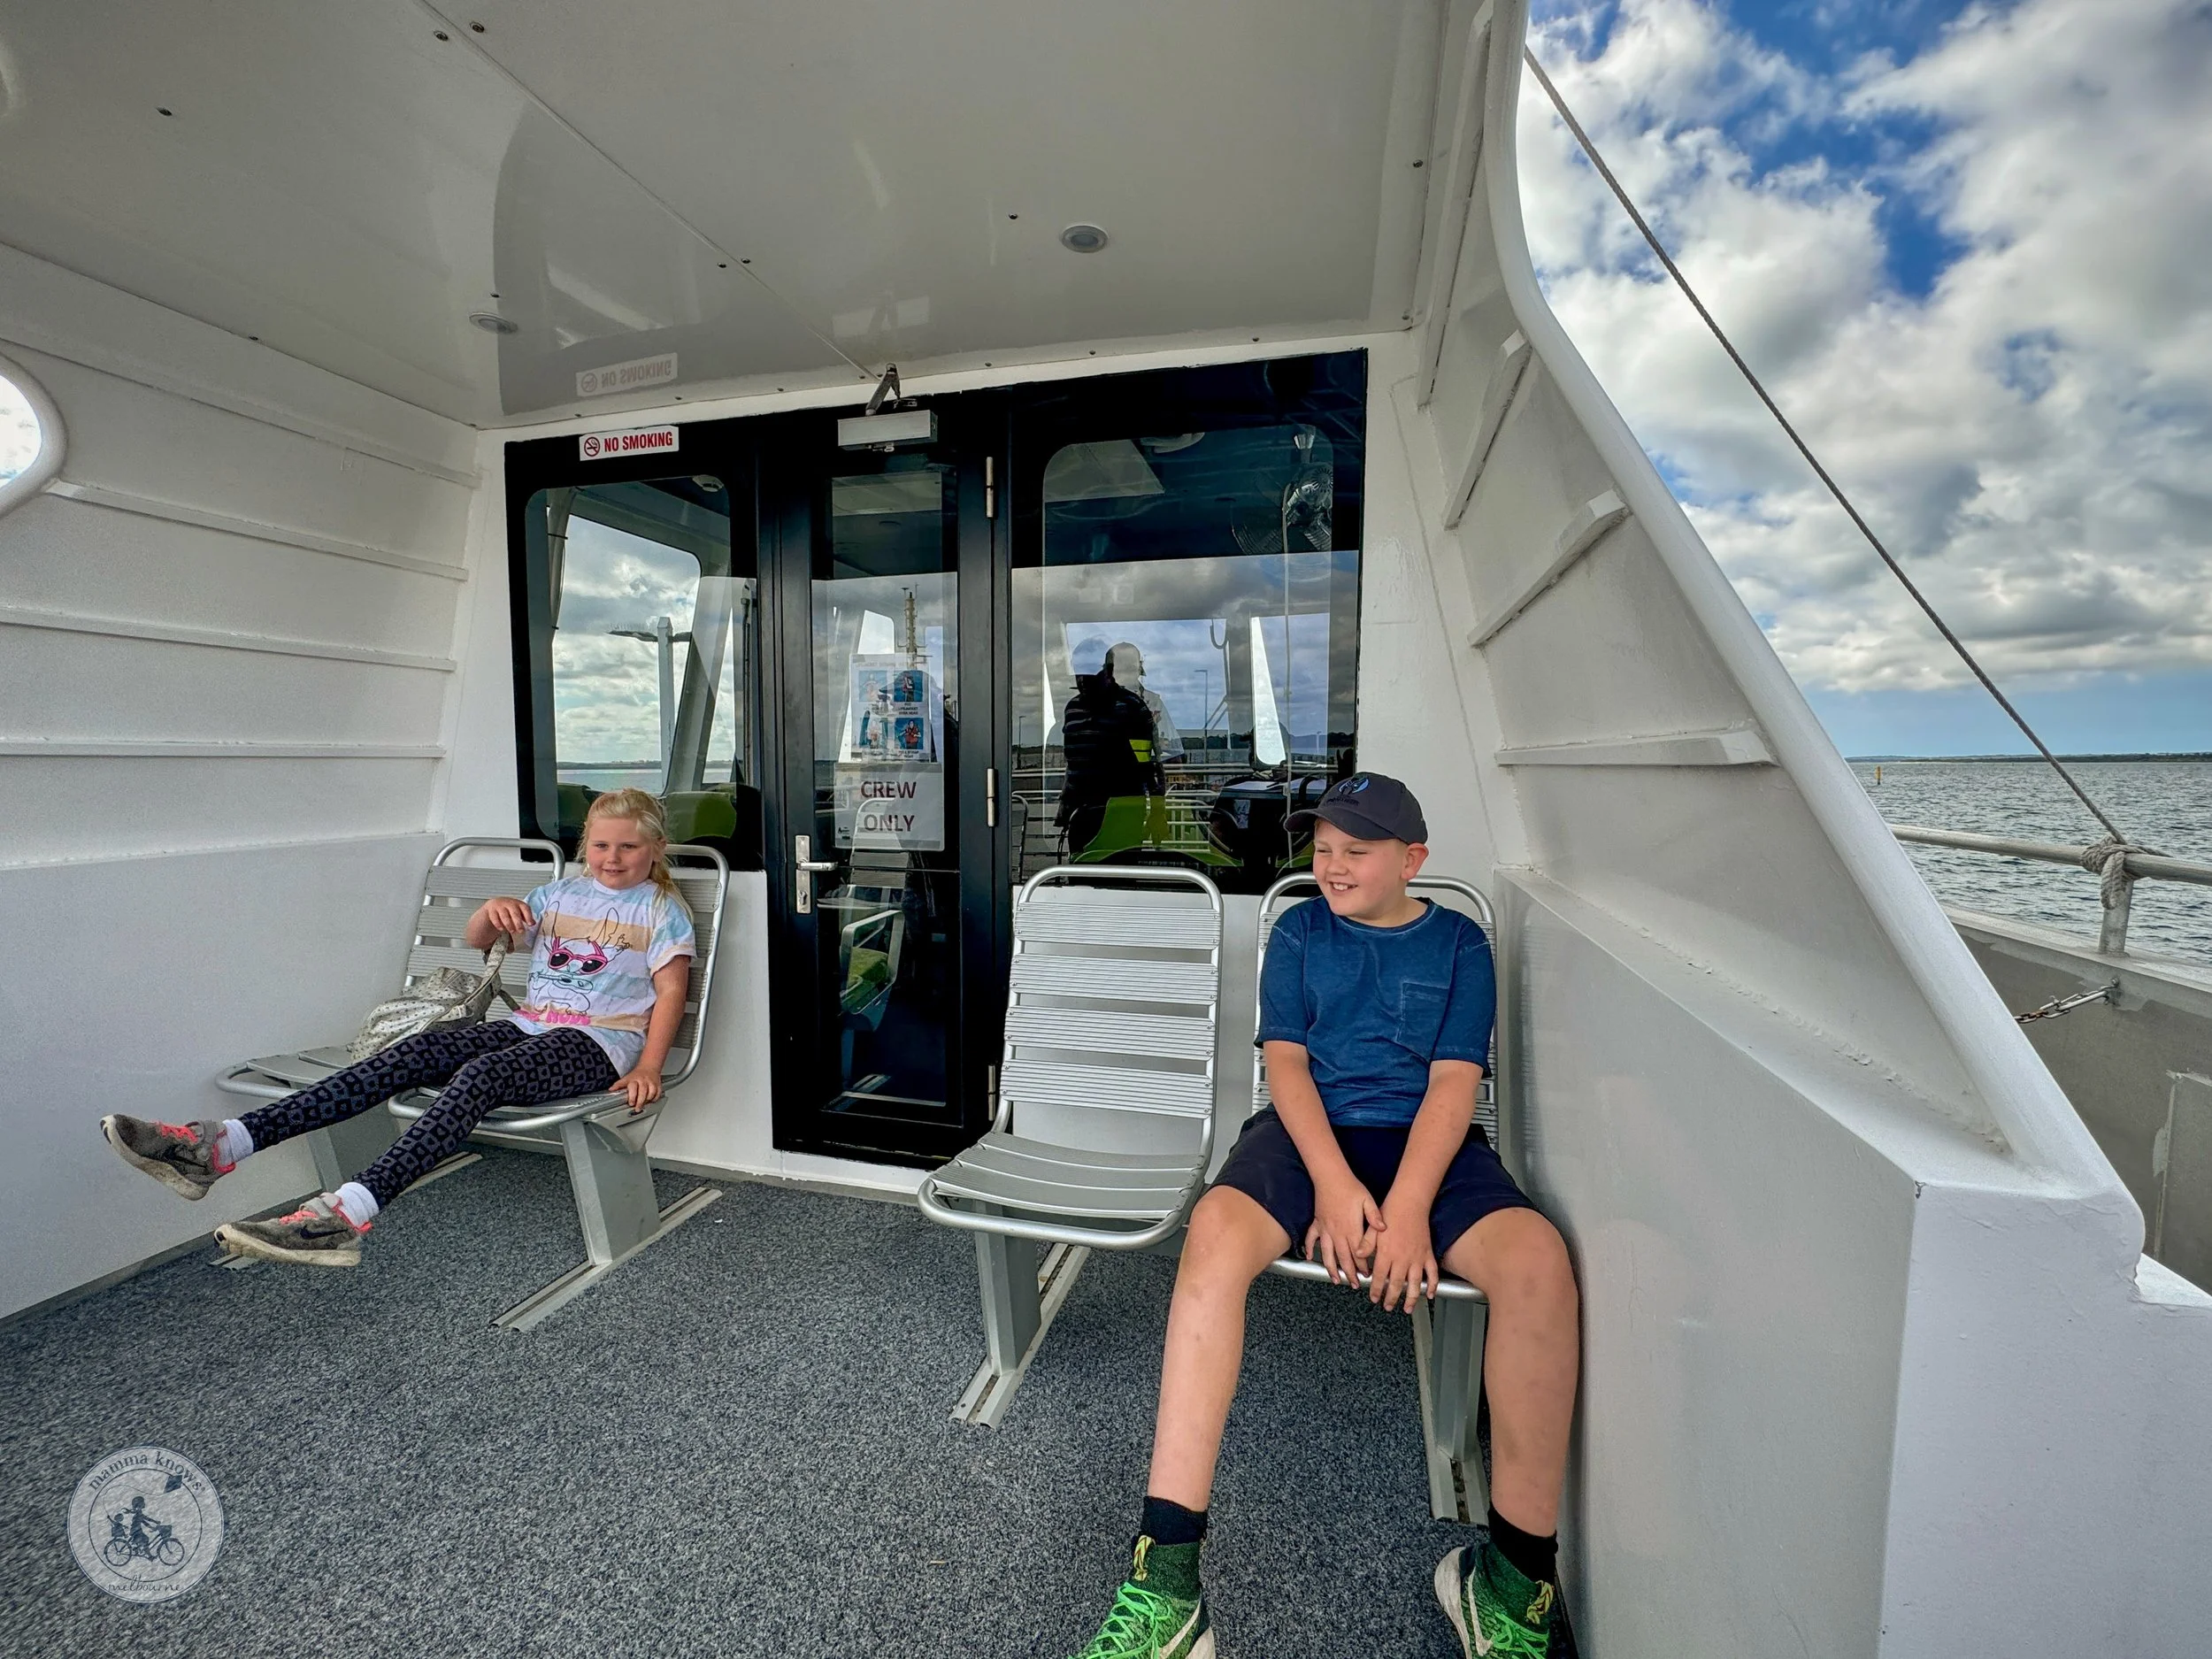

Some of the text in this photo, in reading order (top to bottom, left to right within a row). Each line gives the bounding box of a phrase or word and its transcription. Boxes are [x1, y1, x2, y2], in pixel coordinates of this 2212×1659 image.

[604, 431, 673, 452] NO SMOKING
[860, 780, 917, 799] CREW
[864, 814, 915, 832] ONLY
